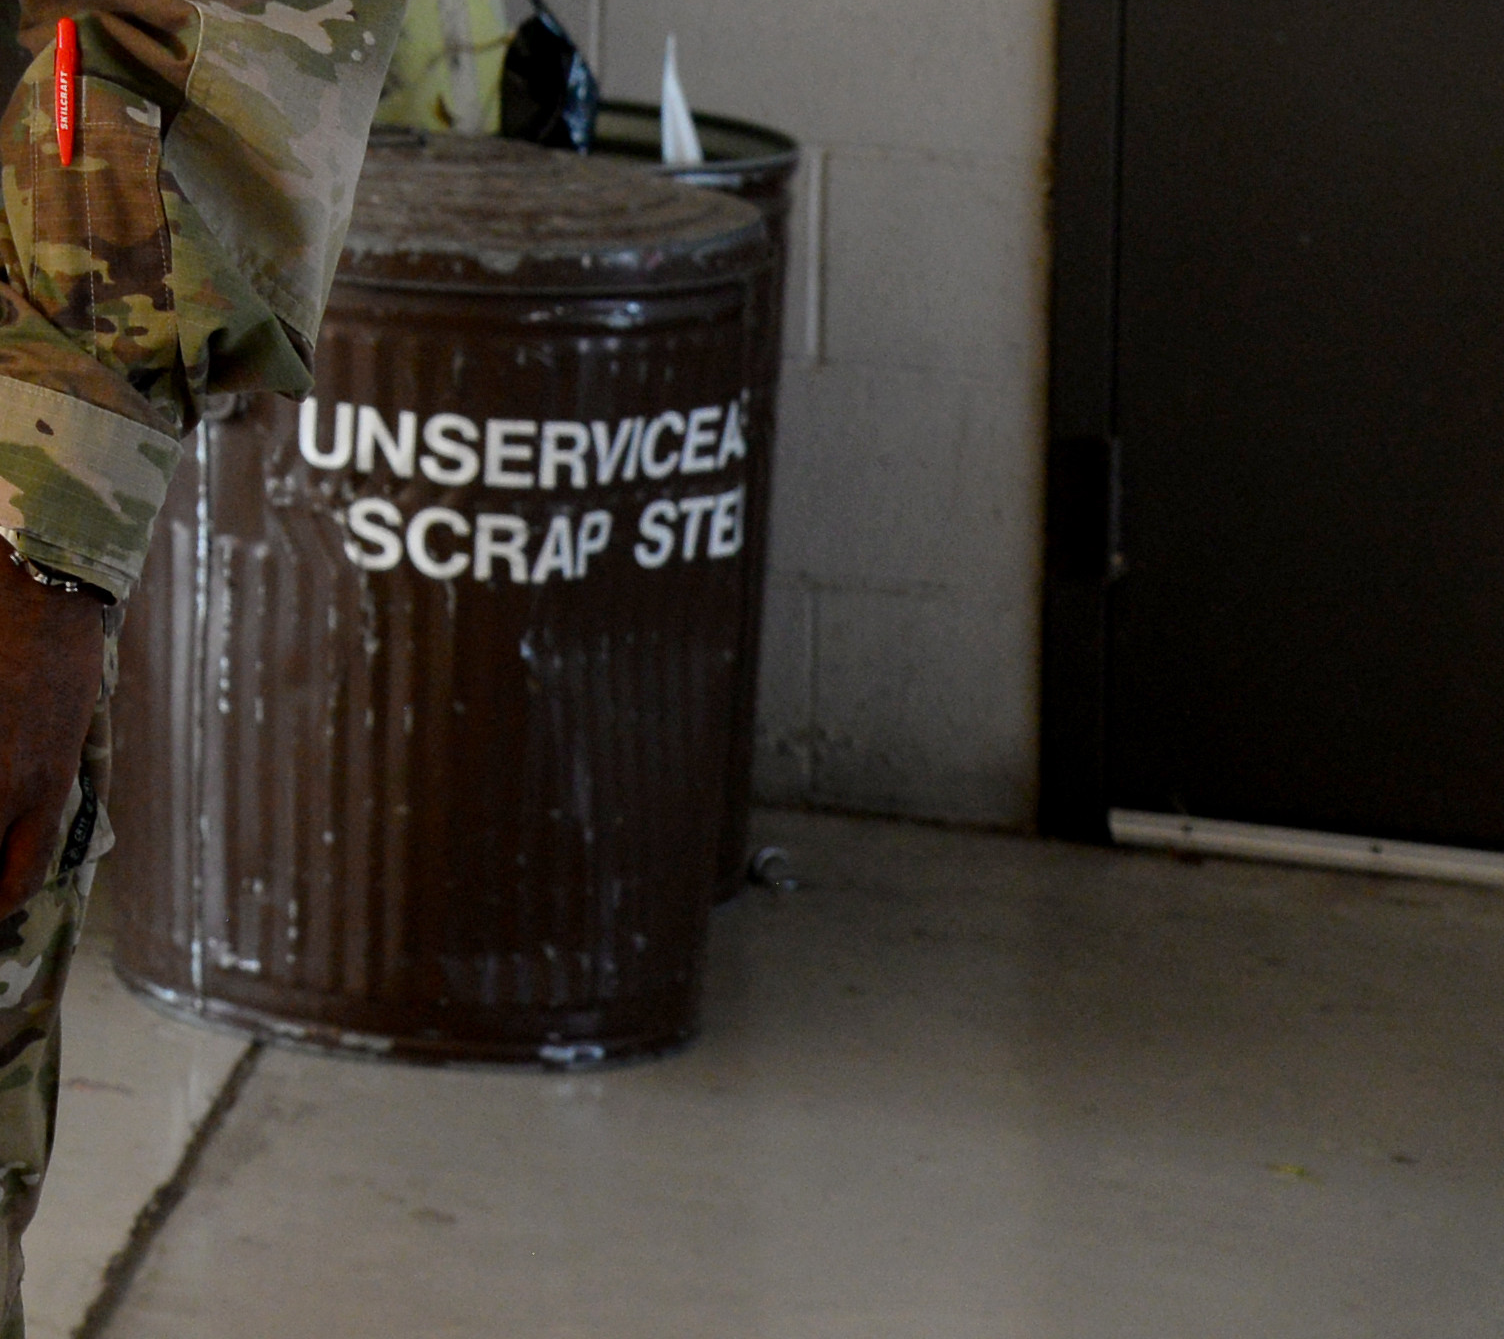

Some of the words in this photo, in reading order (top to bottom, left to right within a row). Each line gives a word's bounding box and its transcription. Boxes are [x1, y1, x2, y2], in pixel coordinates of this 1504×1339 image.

[60, 71, 69, 130] SKILCRAFT
[297, 394, 748, 490] UNSERVICEA
[345, 496, 612, 584] SCRAP
[633, 486, 747, 569] STE
